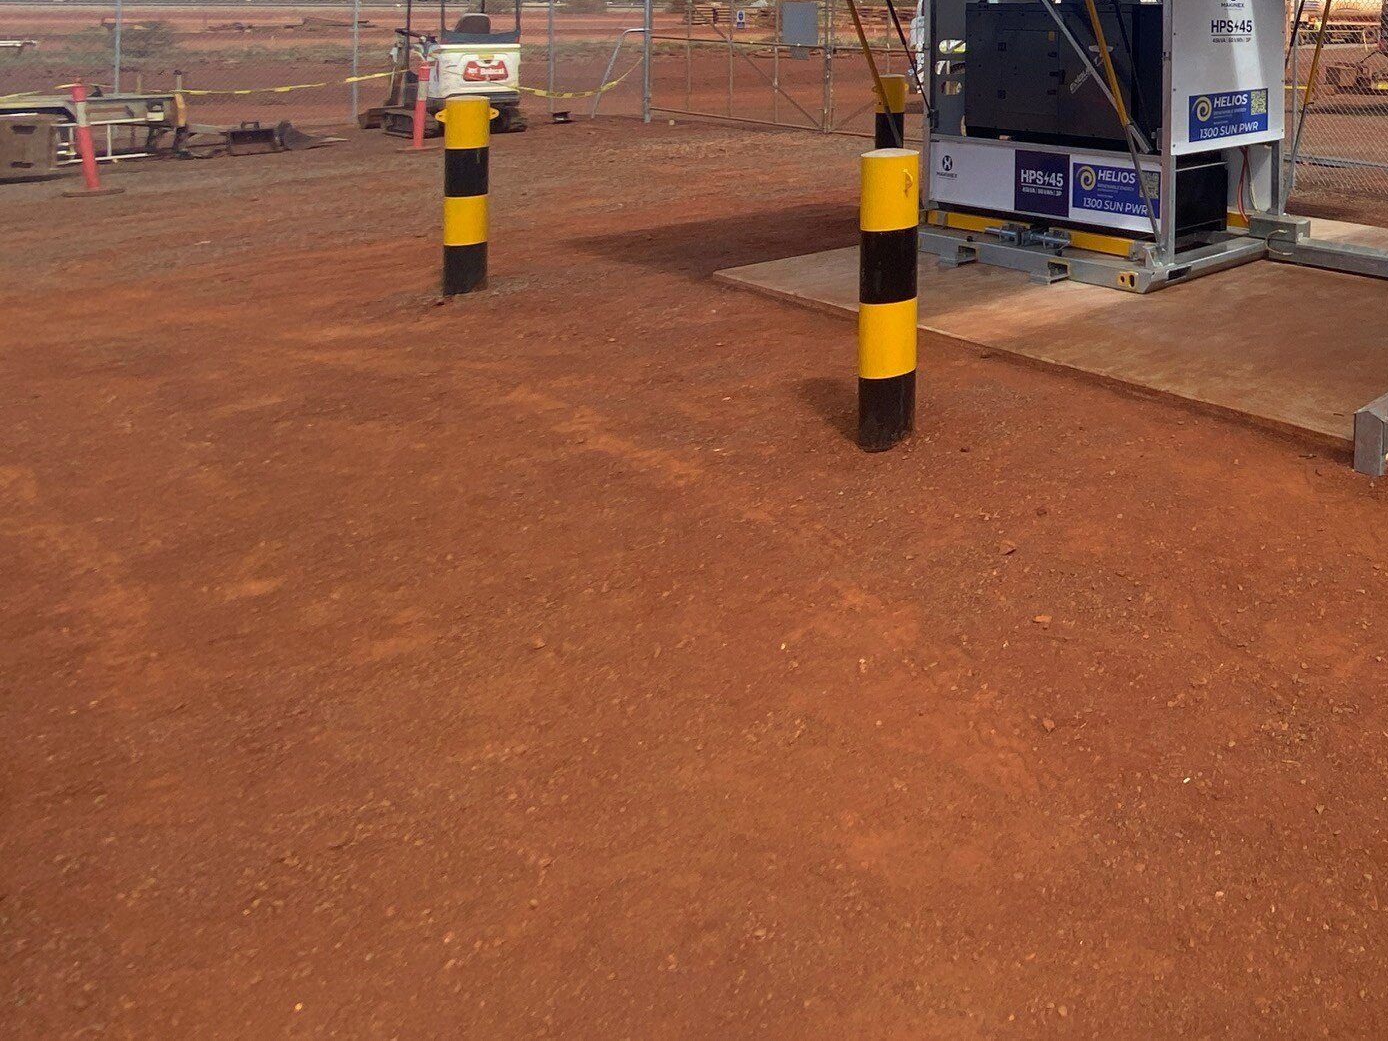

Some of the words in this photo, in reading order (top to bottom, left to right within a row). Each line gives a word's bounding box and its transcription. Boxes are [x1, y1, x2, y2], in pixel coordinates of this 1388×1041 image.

[1213, 93, 1248, 108] HELIOS
[1200, 127, 1219, 139] 1300
[1220, 124, 1237, 136] SUN
[1239, 121, 1259, 133] PWR
[1097, 169, 1136, 184] HELIOS
[1083, 197, 1103, 209] 1300
[1104, 200, 1123, 212] SUN
[1125, 203, 1148, 216] PWR
